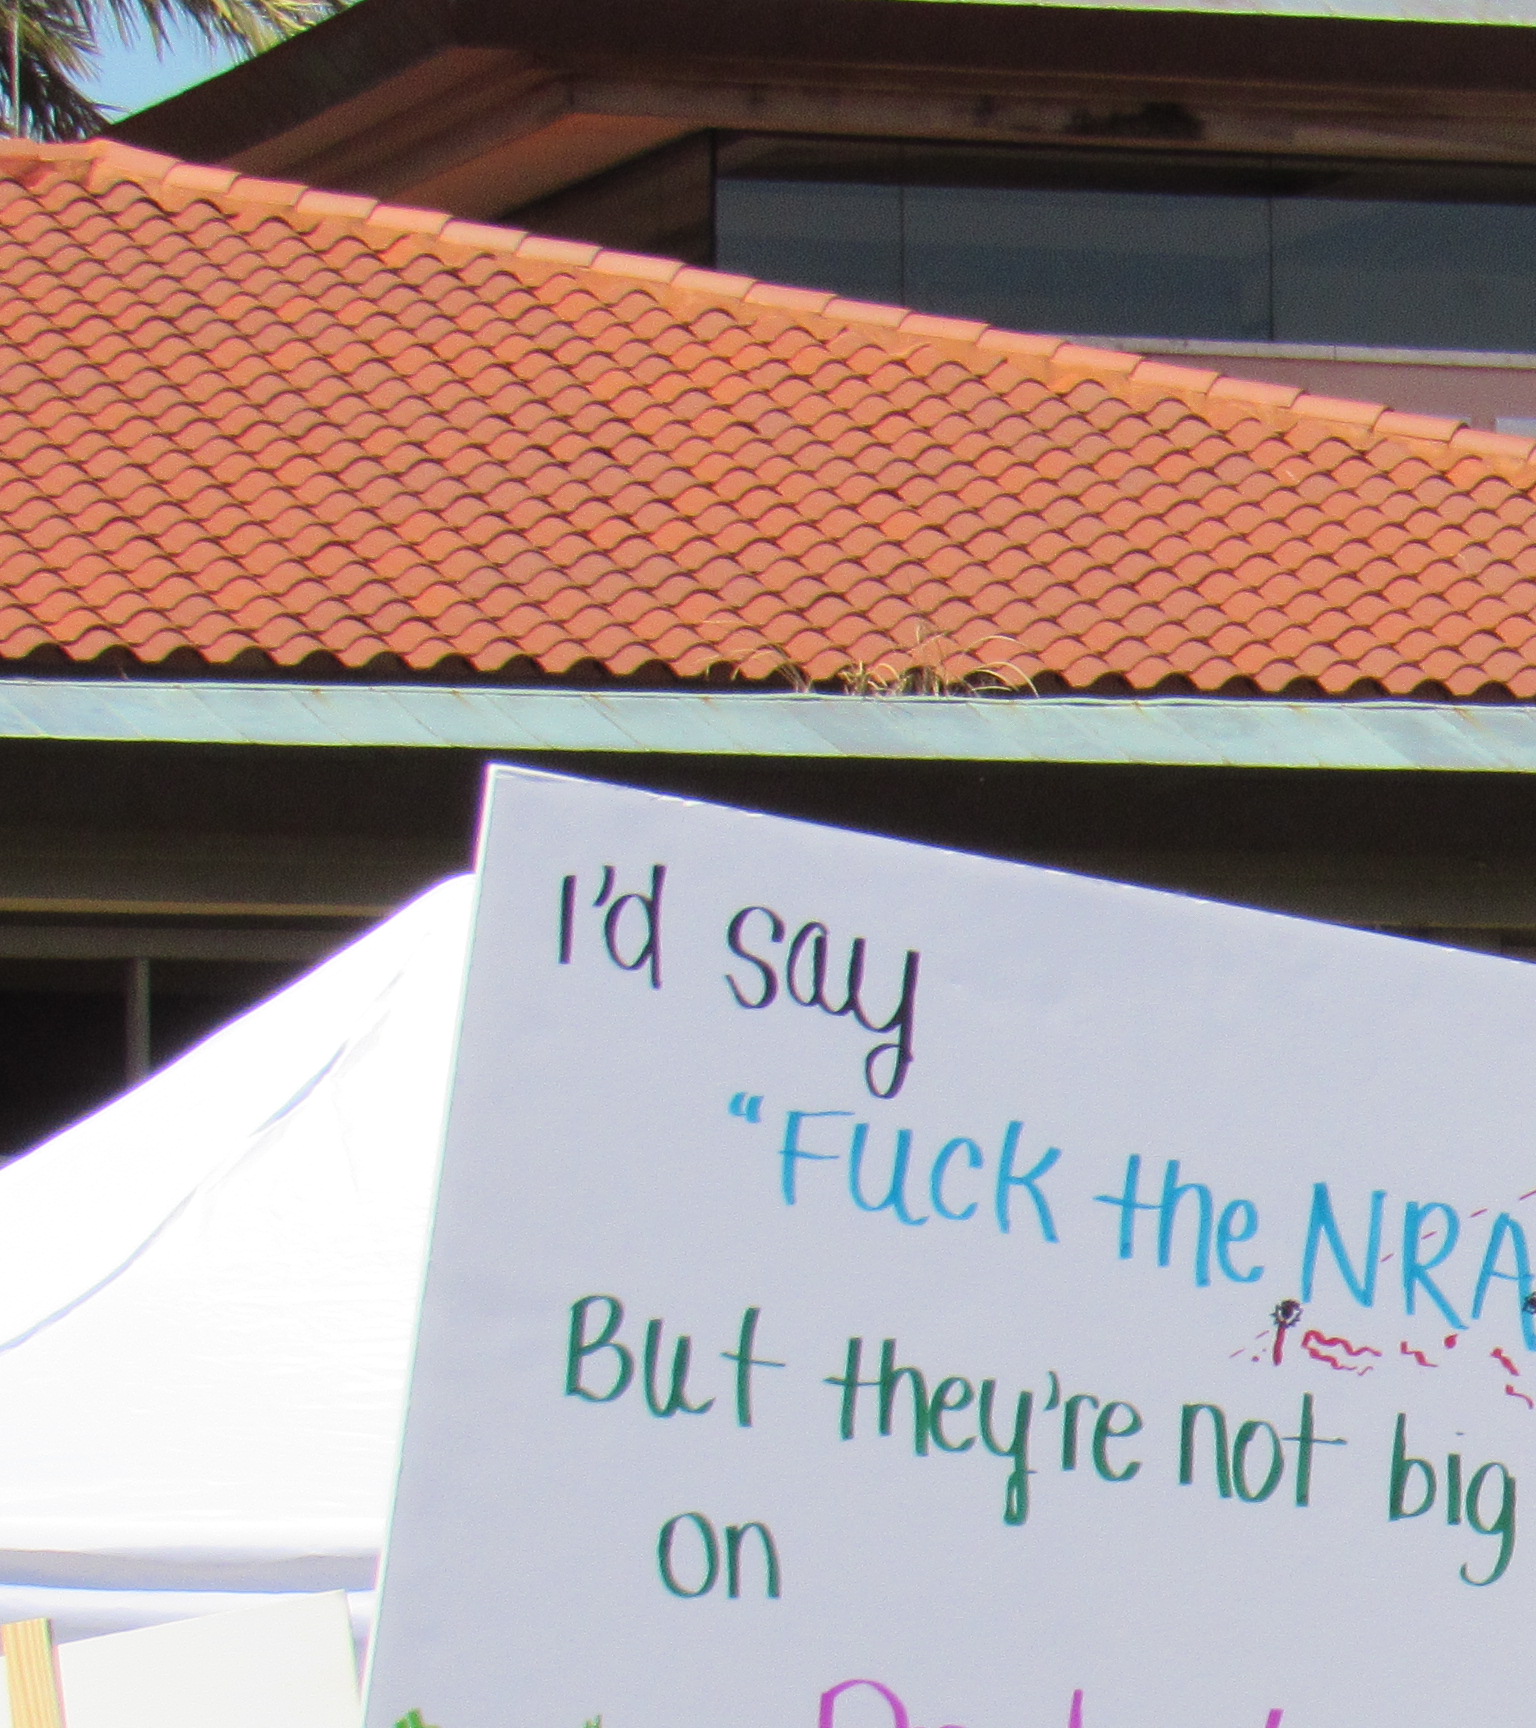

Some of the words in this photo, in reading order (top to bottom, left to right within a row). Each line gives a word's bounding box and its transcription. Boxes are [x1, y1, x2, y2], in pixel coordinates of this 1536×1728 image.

[557, 864, 667, 990] I'd
[721, 905, 920, 1099] say
[1094, 1152, 1265, 1287] the
[565, 1294, 786, 1428] But
[824, 1334, 1144, 1527] they're
[1177, 1392, 1347, 1508] not
[1389, 1411, 1519, 1587] big
[656, 1511, 783, 1600] on
